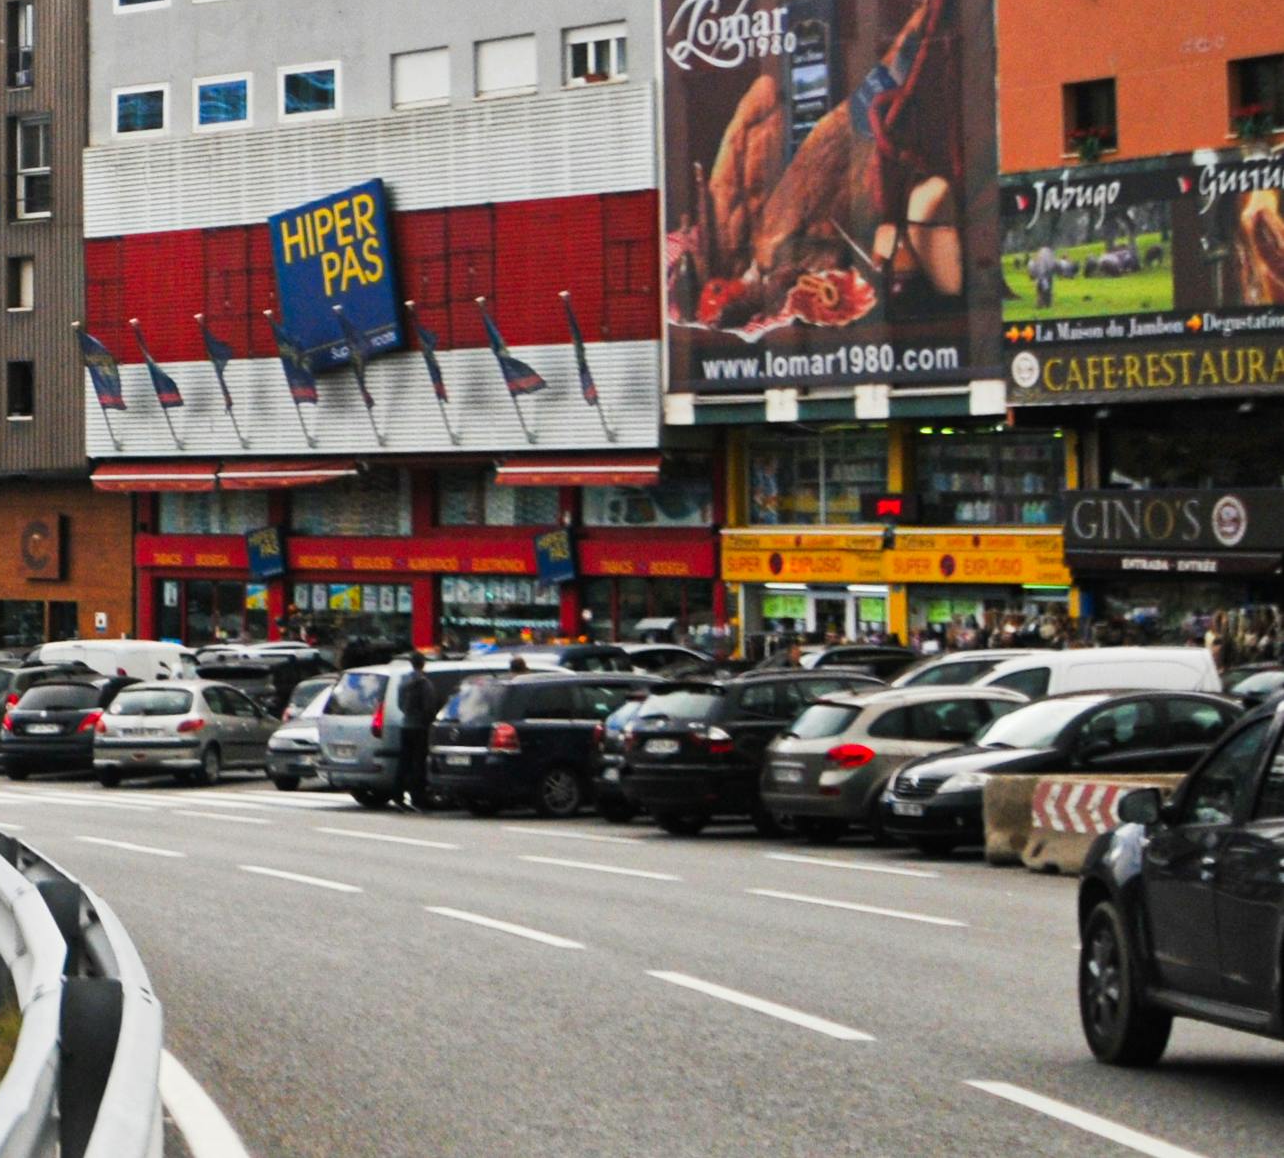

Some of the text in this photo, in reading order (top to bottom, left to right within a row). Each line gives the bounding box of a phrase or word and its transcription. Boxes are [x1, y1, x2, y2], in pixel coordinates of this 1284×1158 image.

[747, 32, 797, 57] 1980
[1025, 169, 1121, 230] Jabugo
[280, 194, 377, 264] HIPER
[321, 237, 384, 297] PAS
[1035, 317, 1183, 342] La Maison du Jambon
[702, 344, 959, 380] www.lomar1980.com
[1071, 499, 1202, 541] GINO'S
